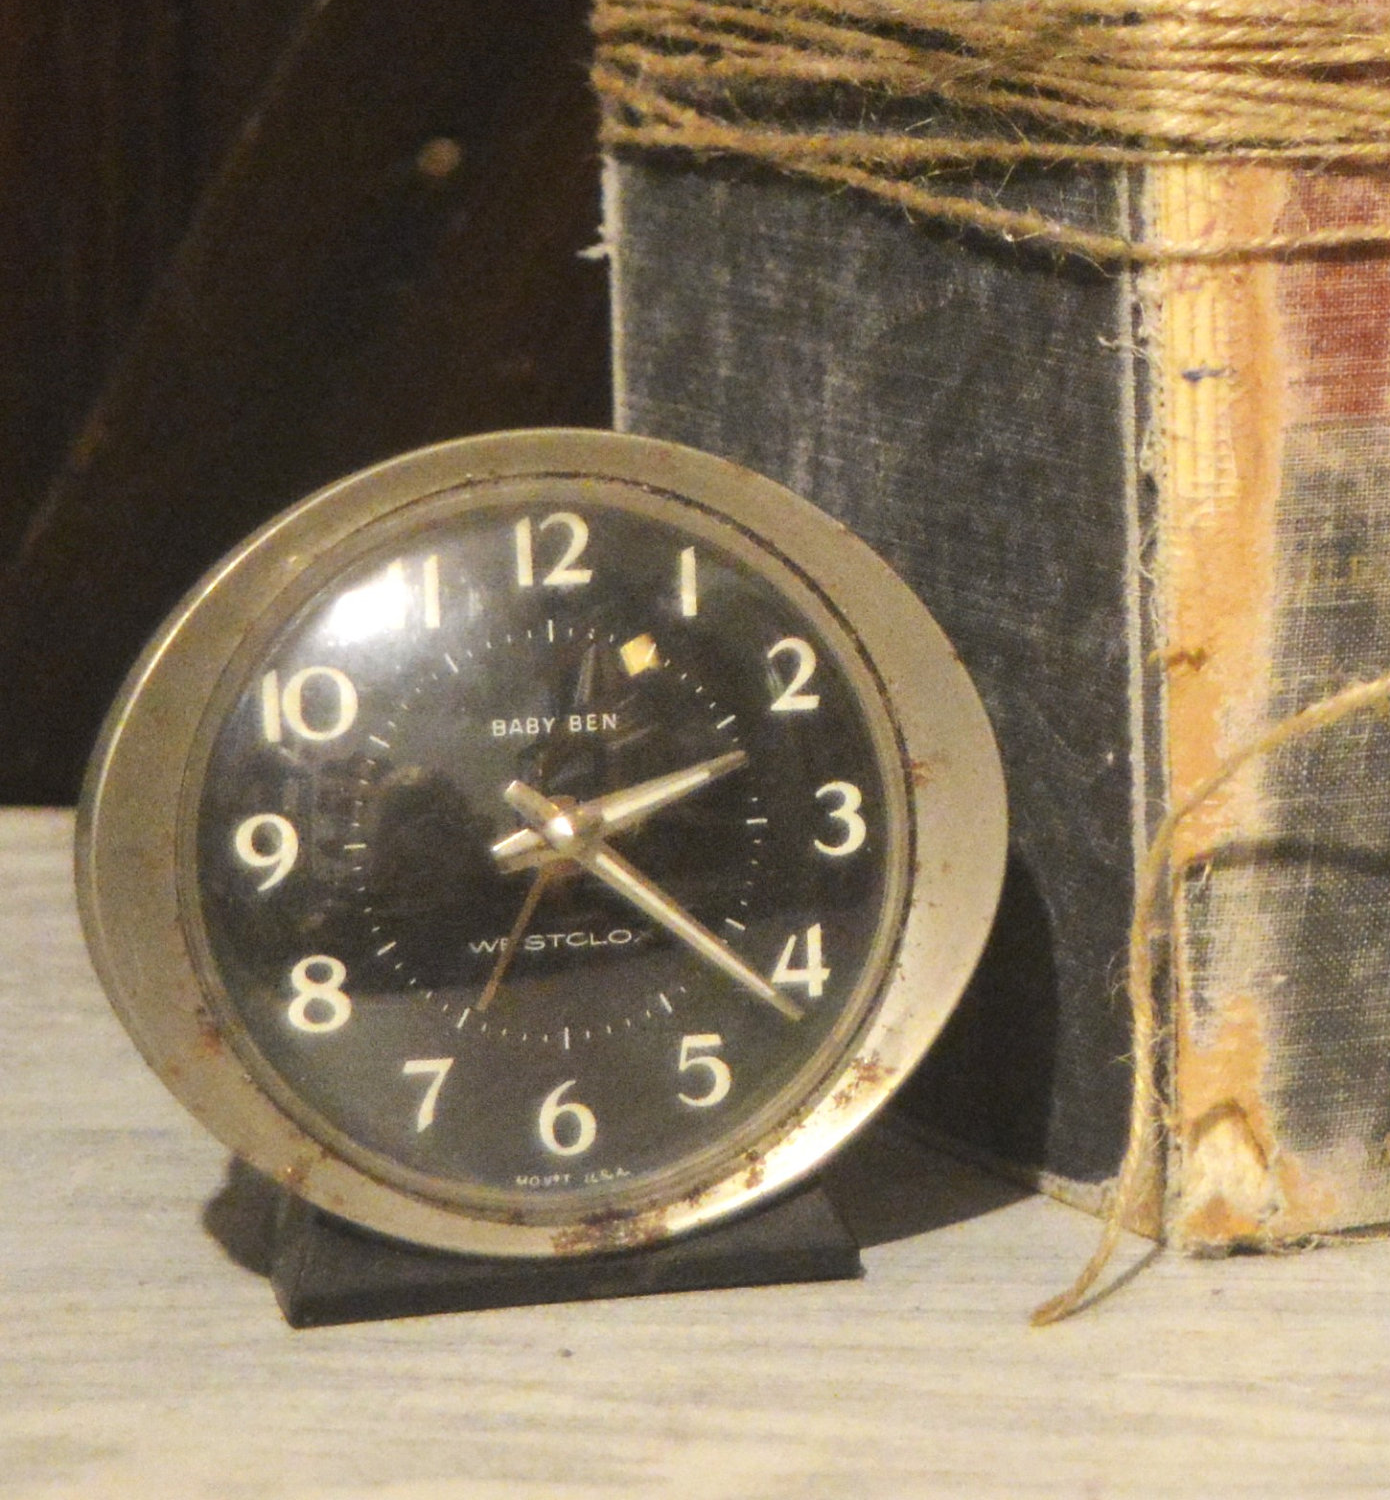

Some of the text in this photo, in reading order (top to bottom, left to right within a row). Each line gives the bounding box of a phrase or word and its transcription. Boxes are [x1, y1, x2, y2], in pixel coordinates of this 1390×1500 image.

[516, 512, 593, 587] 12
[679, 546, 698, 616] 1
[263, 666, 359, 744] 10
[767, 637, 820, 712] 2
[492, 713, 617, 736] BABY BEN
[235, 814, 298, 892] 9
[813, 781, 866, 857] 3
[469, 929, 650, 953] WSTCLO
[771, 923, 831, 997] 4
[286, 955, 352, 1033] 8
[403, 1057, 454, 1132] 7
[677, 1034, 731, 1107] 5
[538, 1080, 597, 1156] 6
